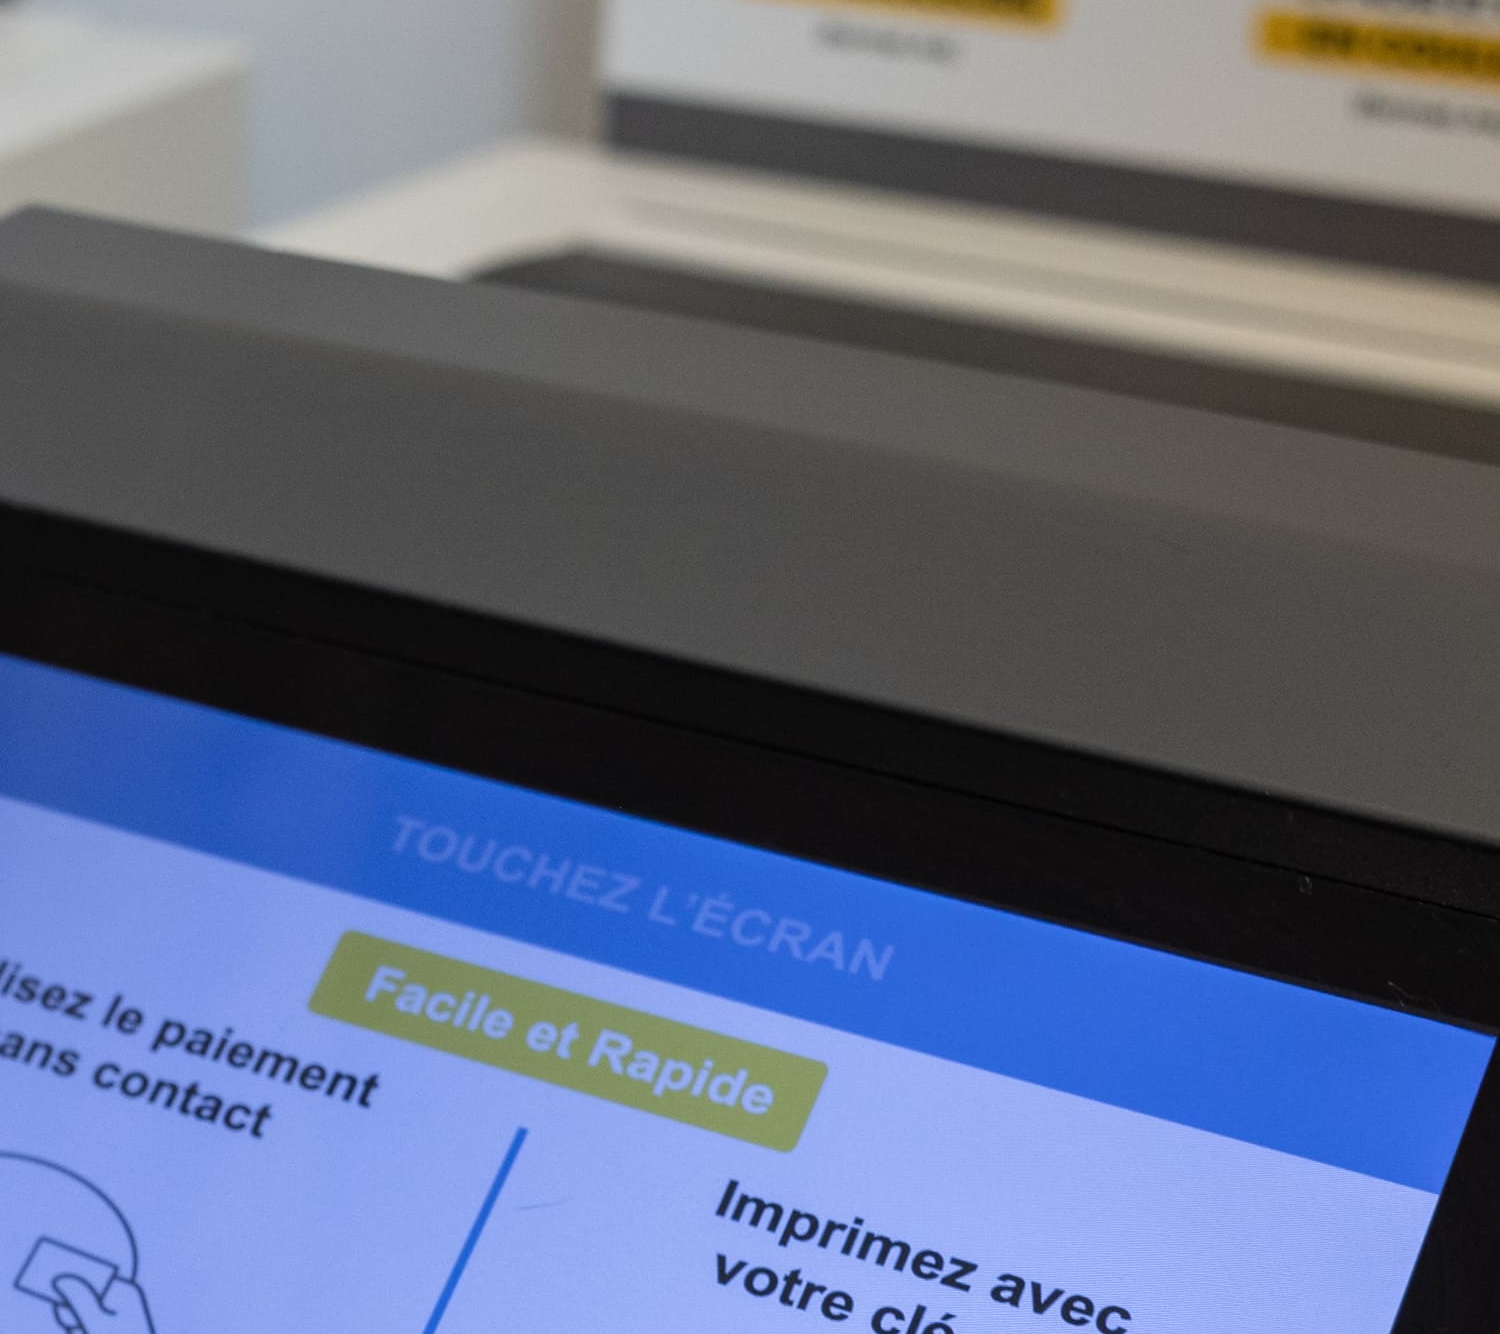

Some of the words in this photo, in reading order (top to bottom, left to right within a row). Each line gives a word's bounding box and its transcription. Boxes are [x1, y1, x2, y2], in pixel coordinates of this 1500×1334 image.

[390, 816, 640, 913] TOUCHEZ
[649, 886, 895, 981] L'ÉCRAN
[103, 994, 145, 1035] le
[150, 1016, 380, 1108] paiement
[365, 966, 514, 1040] Facile
[526, 1021, 580, 1060] et
[588, 1029, 774, 1115] Rapide
[92, 1062, 273, 1139] contact
[715, 1179, 979, 1292] Imprimez
[715, 1252, 855, 1322] votre
